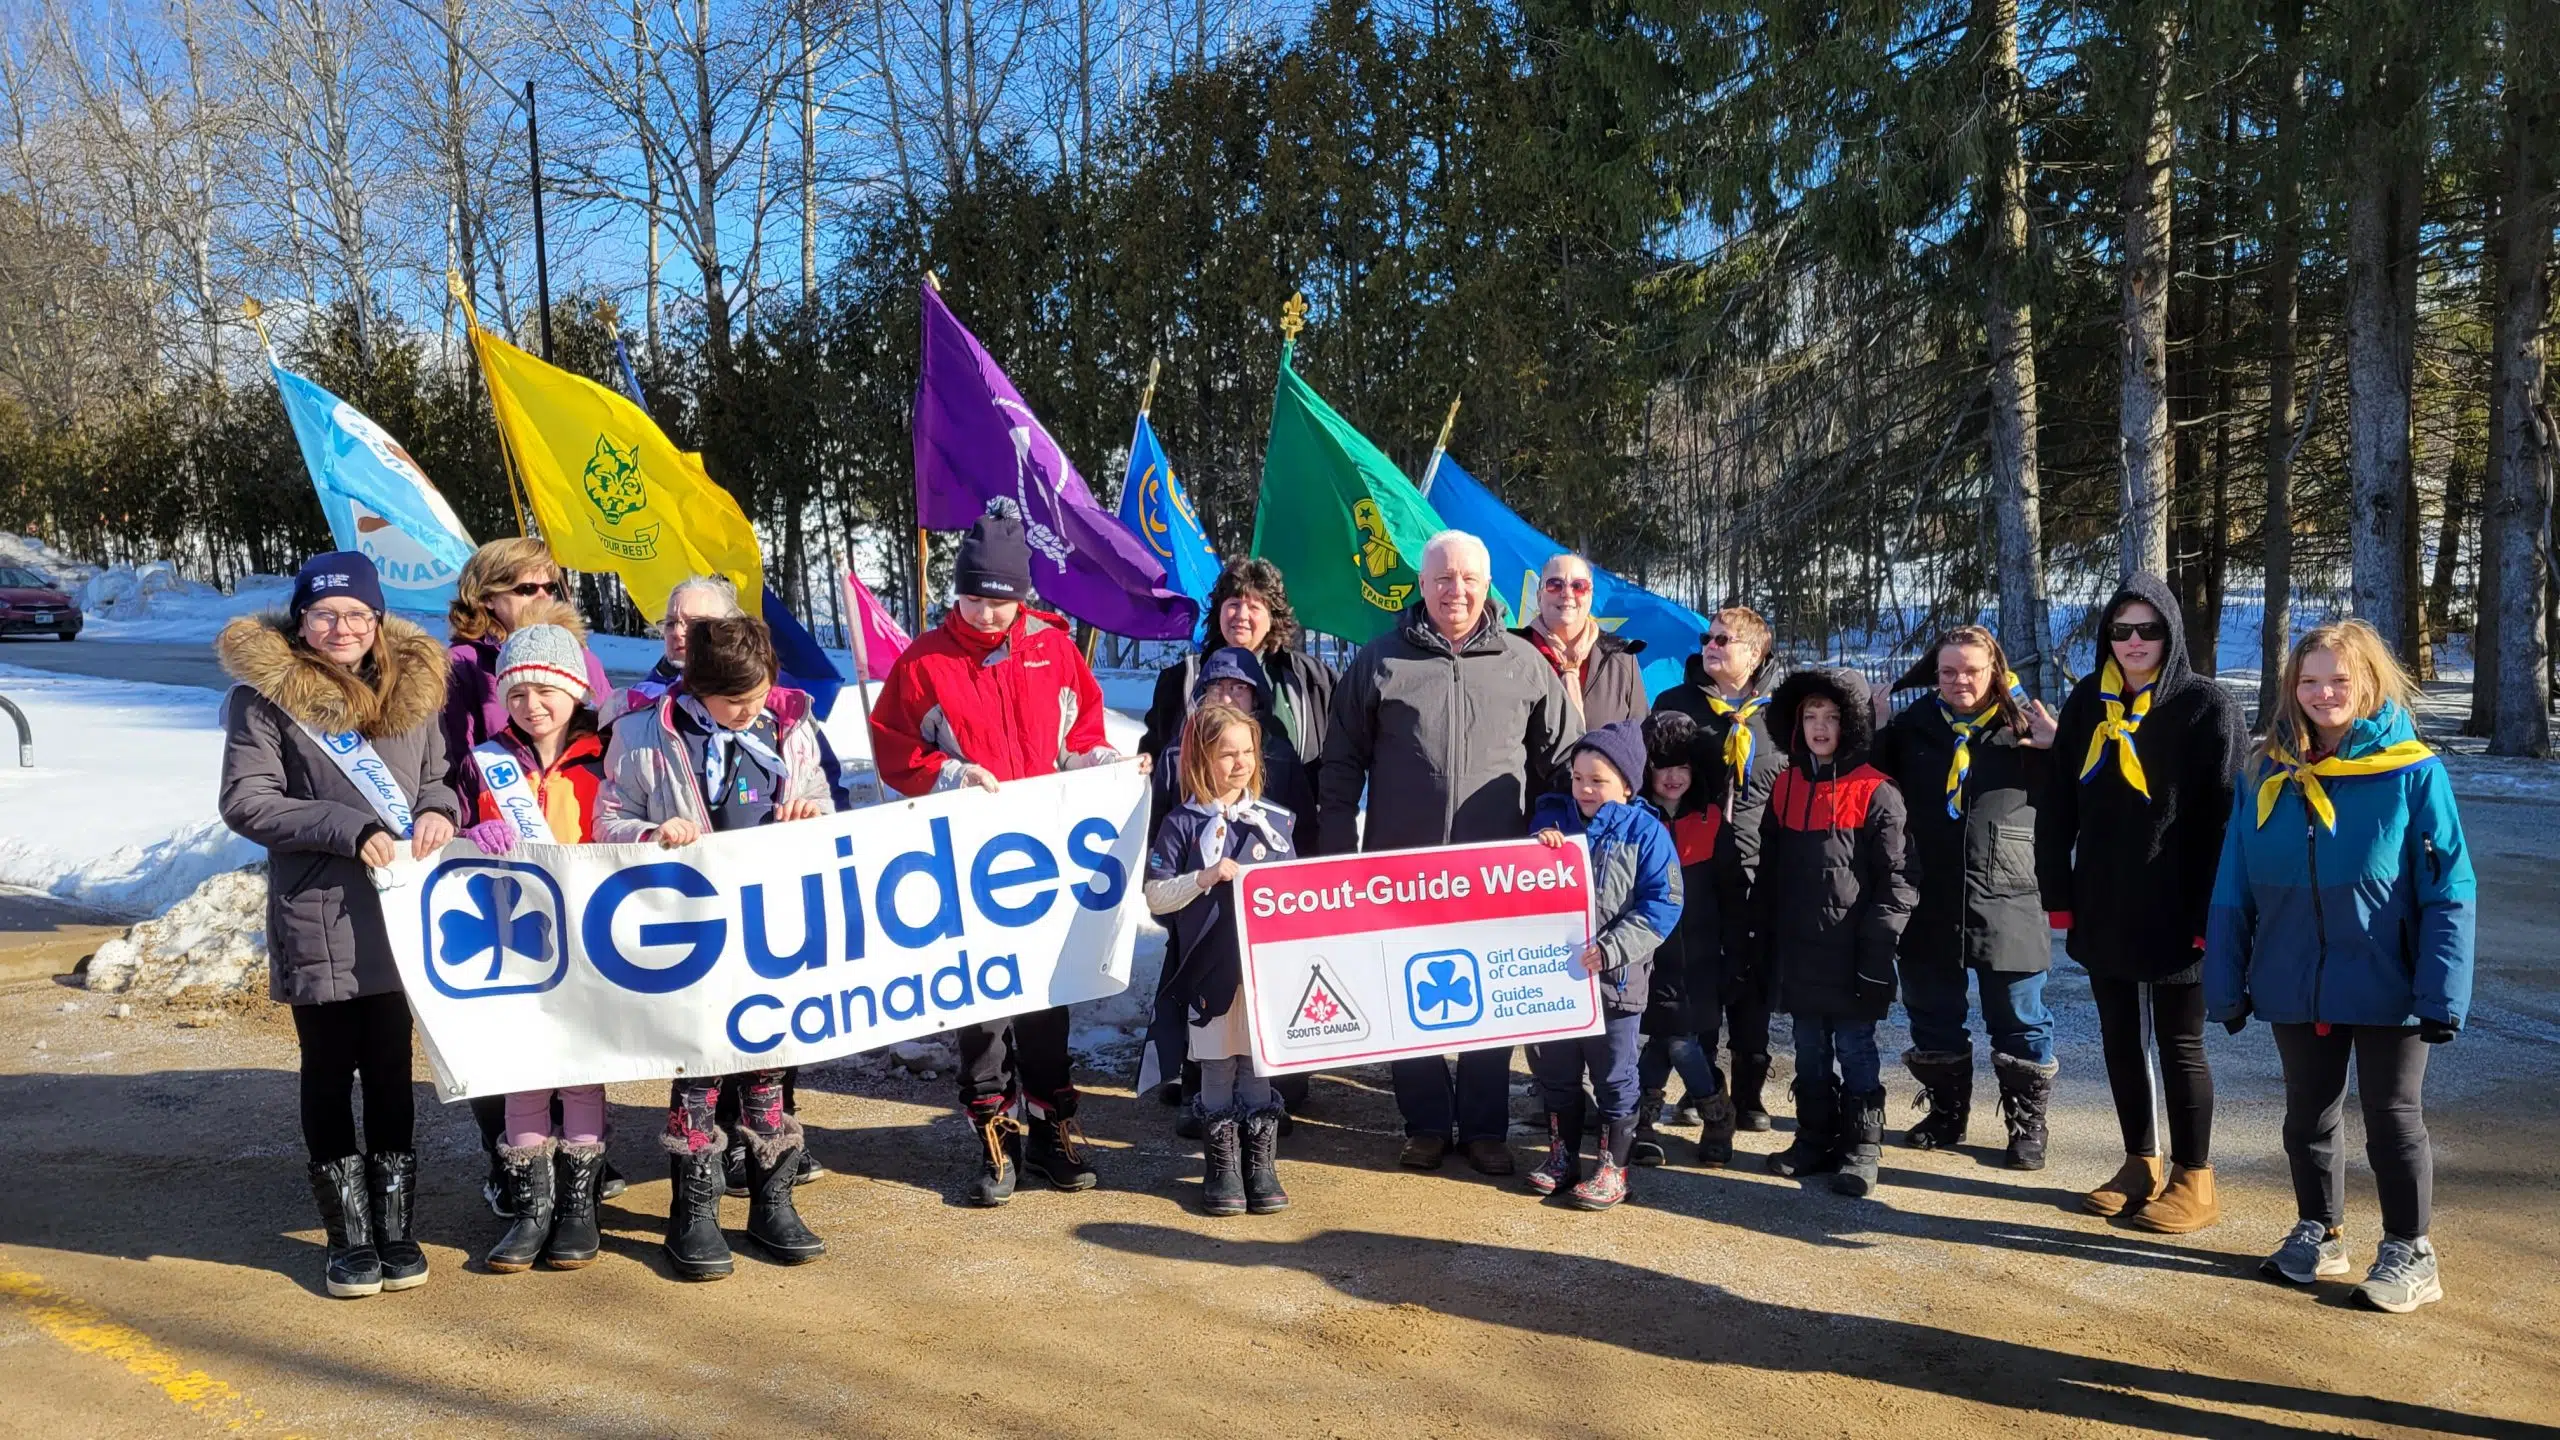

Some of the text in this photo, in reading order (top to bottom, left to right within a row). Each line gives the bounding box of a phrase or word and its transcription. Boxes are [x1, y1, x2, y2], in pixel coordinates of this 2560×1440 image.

[362, 540, 452, 582] CANAD
[622, 544, 648, 556] BEST
[1362, 585, 1398, 609] EPARED
[352, 758, 395, 800] Guides
[500, 796, 542, 839] Guides
[1252, 860, 1578, 918] Scout-Guide Week
[581, 815, 1128, 994] Guides
[1487, 944, 1570, 964] Girl Guides
[1489, 959, 1568, 979] of Canada
[726, 949, 1024, 1054] Canada
[1492, 985, 1544, 1003] Guides
[1494, 997, 1576, 1018] du Canada
[1286, 1021, 1360, 1039] SCOUTS CANADA
